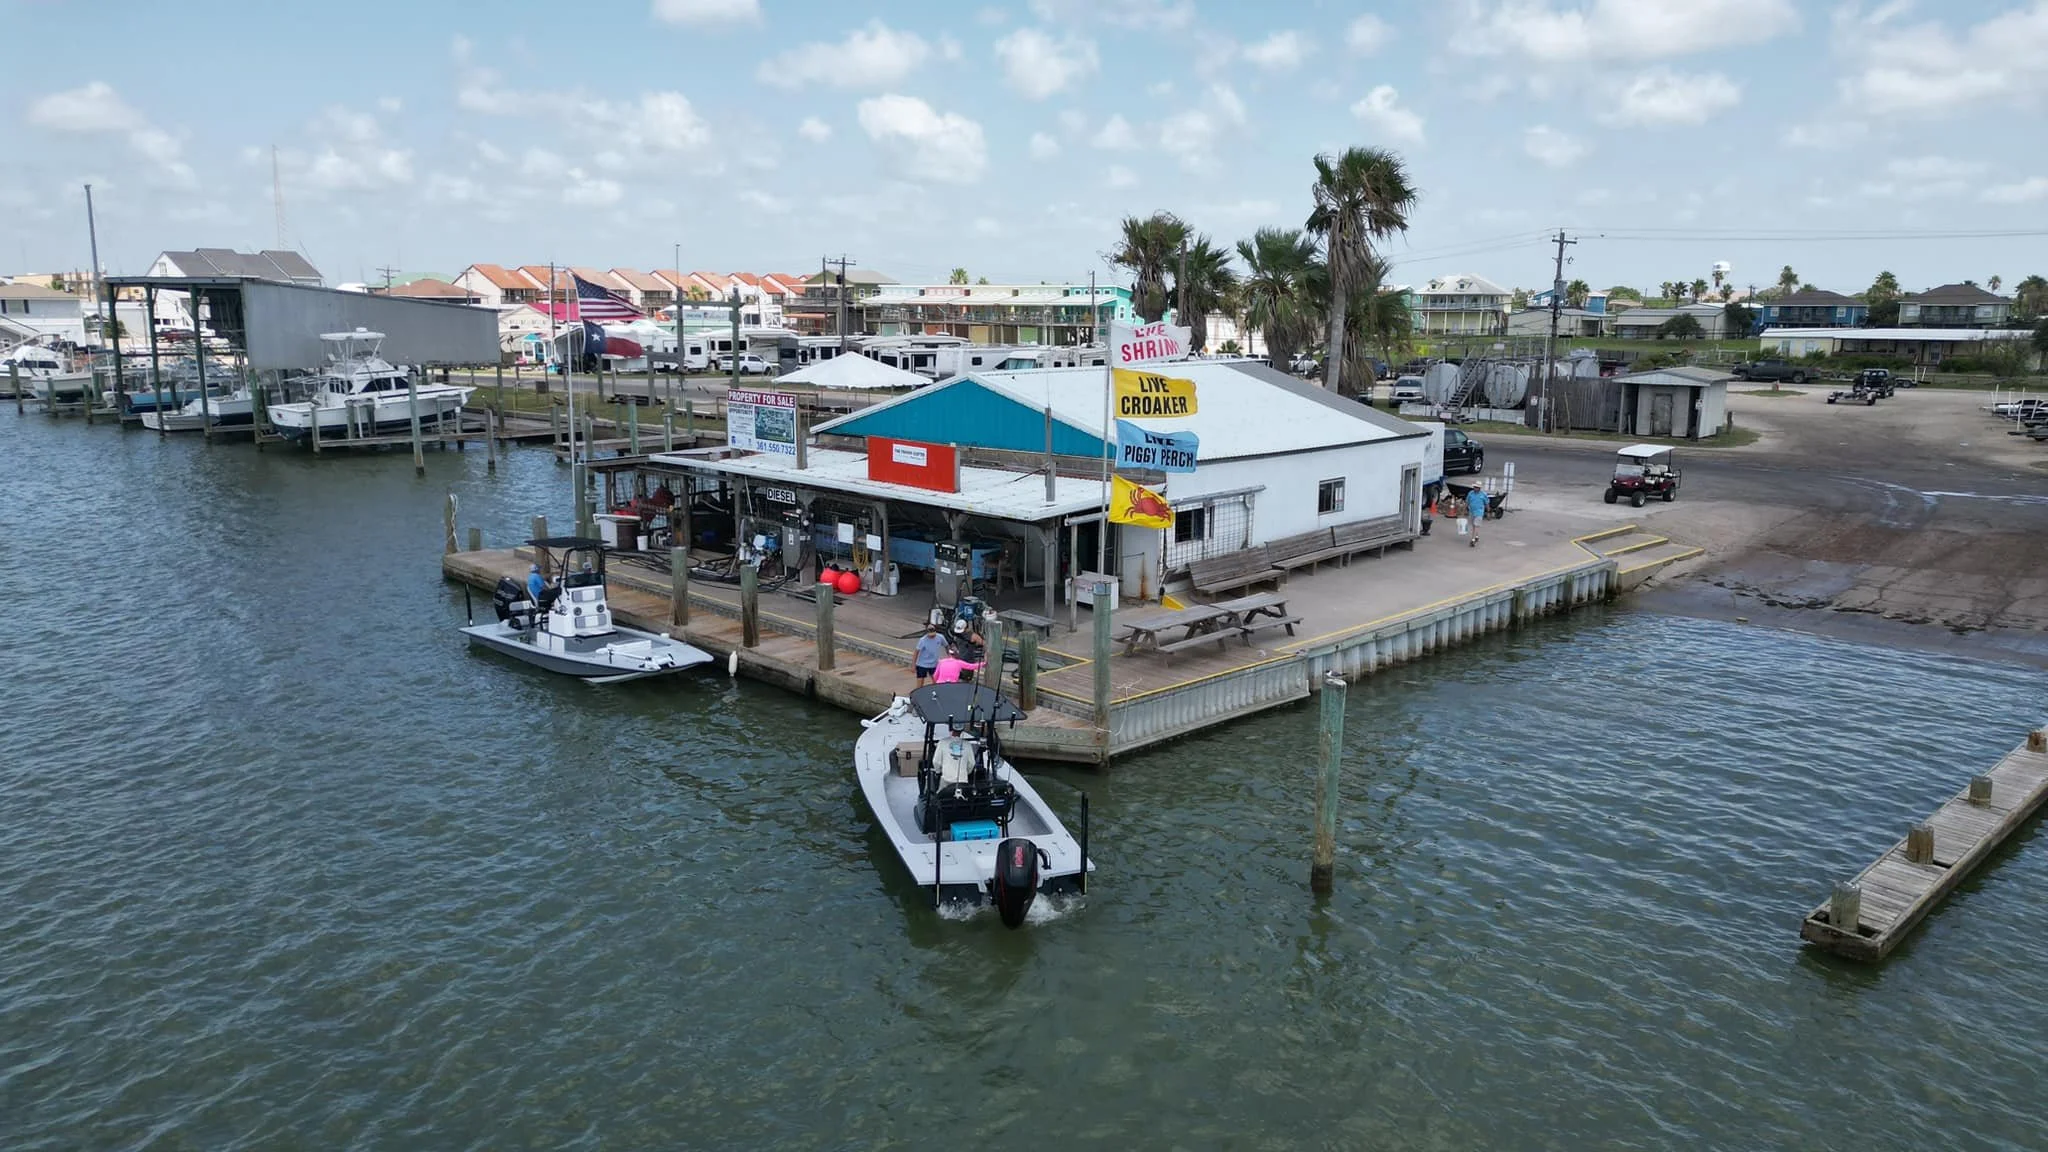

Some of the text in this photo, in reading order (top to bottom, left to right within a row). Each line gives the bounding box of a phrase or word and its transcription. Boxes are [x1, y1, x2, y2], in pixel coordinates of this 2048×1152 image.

[1121, 339, 1179, 362] SHRIM
[1138, 376, 1170, 393] LIVE
[728, 390, 794, 407] PROPERTY FOR SALE
[1121, 396, 1188, 415] CROAKER
[1124, 445, 1194, 468] PIGGY PERCH
[768, 488, 795, 503] DIESEL
